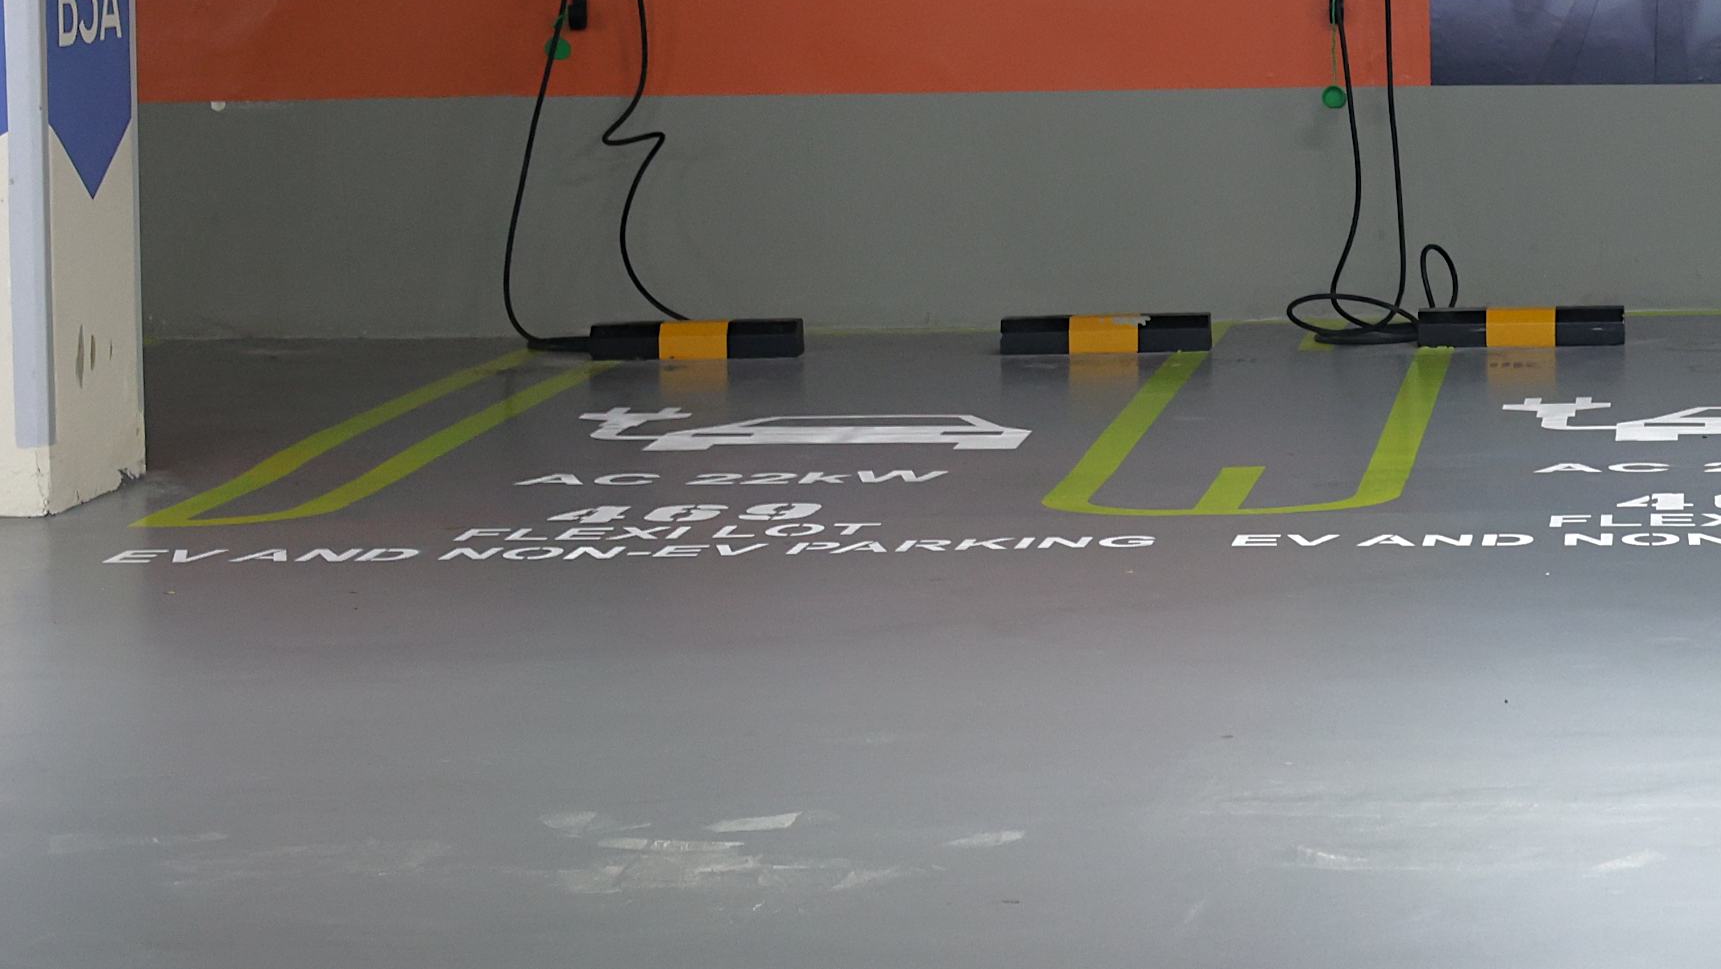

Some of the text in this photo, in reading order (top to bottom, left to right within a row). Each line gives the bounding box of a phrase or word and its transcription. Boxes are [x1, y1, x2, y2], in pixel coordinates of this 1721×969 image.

[1534, 462, 1670, 474] AC
[513, 470, 949, 486] AC 22kW
[546, 502, 822, 524] 469
[452, 522, 882, 542] FLEXI LOT
[1230, 534, 1354, 547] EV
[1356, 534, 1535, 547] AND
[102, 535, 1156, 563] EV AND NON-EV PARKING
